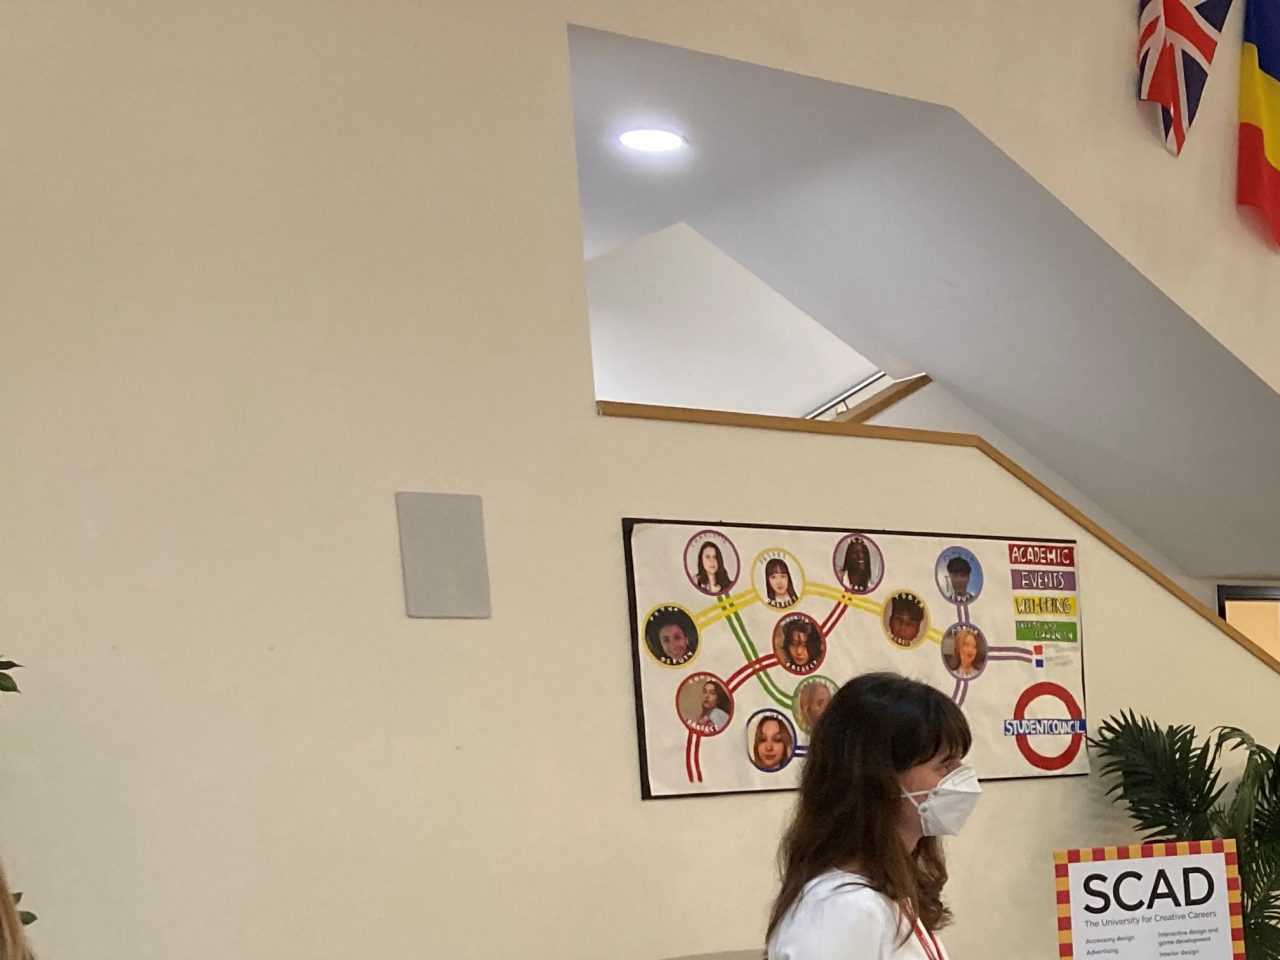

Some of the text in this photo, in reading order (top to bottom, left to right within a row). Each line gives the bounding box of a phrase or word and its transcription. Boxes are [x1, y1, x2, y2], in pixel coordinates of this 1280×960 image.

[1011, 546, 1070, 564] ACADEMIC
[1021, 571, 1065, 588] EVENTS
[1083, 866, 1215, 915] SCAD
[1083, 910, 1217, 928] The University for Creative Careers
